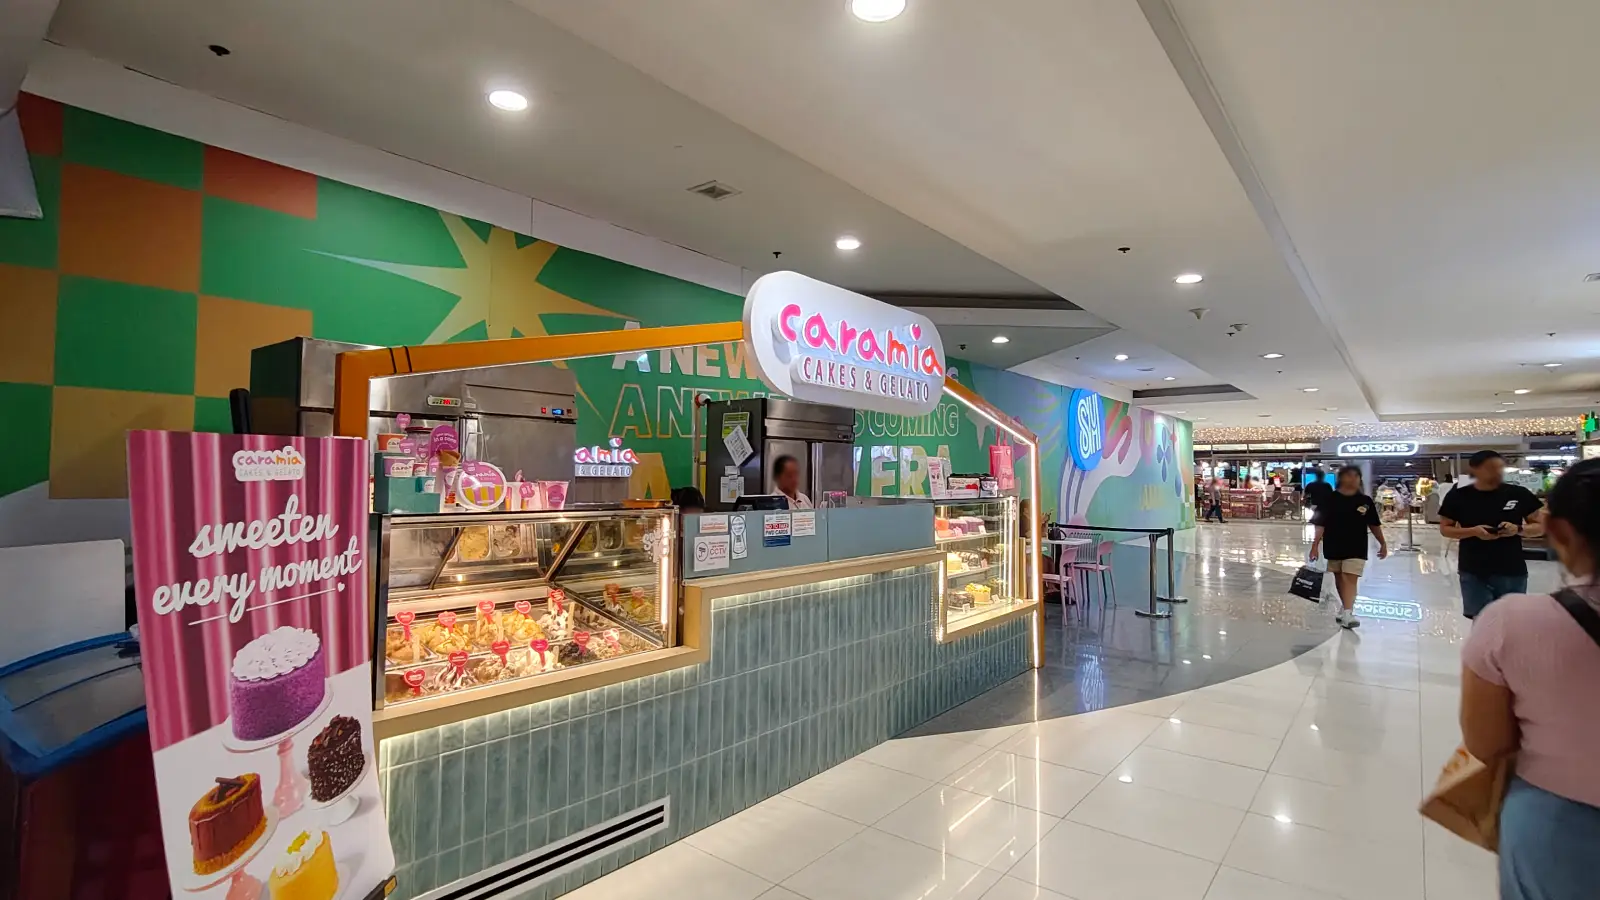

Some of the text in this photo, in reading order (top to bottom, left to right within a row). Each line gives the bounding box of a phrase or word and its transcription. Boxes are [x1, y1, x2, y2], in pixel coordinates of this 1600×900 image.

[778, 303, 943, 376] caramia
[803, 356, 930, 402] CAKES & GELATO
[608, 383, 652, 438] A
[1077, 392, 1102, 459] SM
[237, 450, 302, 466] caramia
[591, 466, 633, 476] GELATO
[1346, 443, 1409, 453] watsons
[188, 494, 339, 558] sweeten
[710, 548, 726, 556] CCTV
[152, 535, 362, 623] every moment
